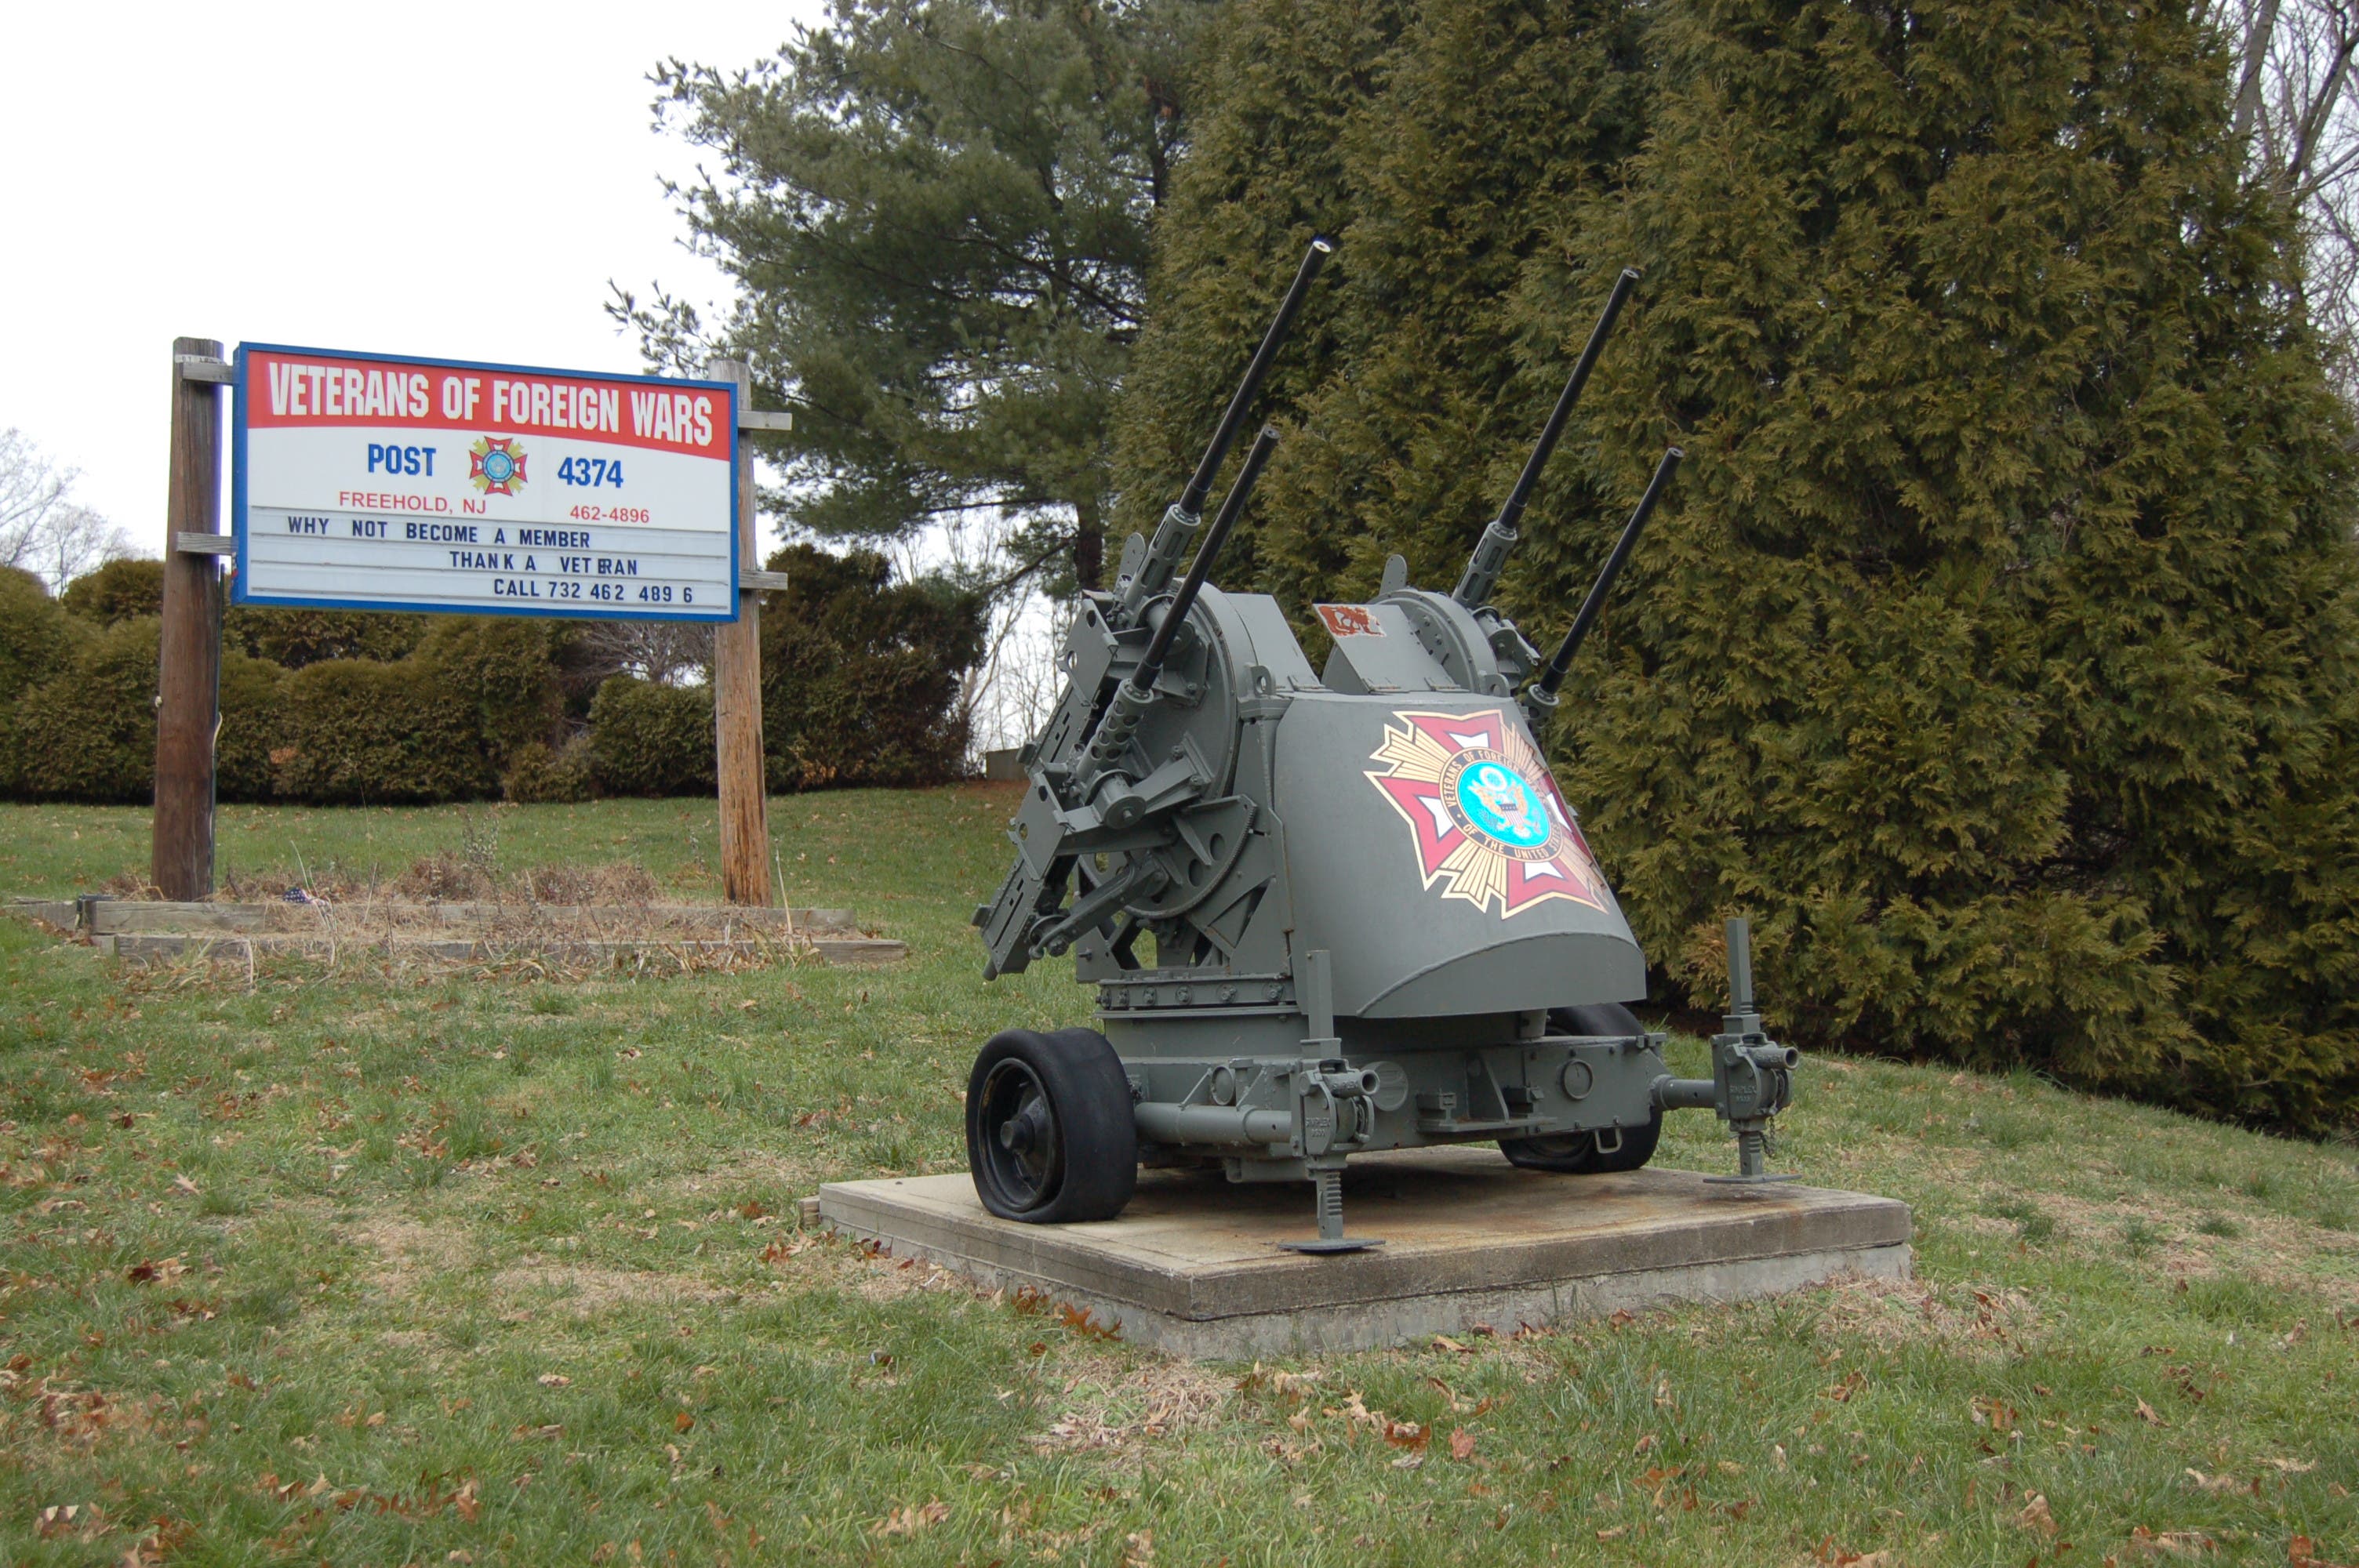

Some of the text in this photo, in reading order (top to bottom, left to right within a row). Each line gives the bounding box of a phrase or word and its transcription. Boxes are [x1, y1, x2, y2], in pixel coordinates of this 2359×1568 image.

[269, 361, 712, 447] VETERANS OF FOREIGN WARS
[368, 443, 623, 488] POST 4374
[340, 491, 486, 514] FREEHOLD, NJ
[570, 506, 649, 523] 462-4896
[288, 516, 590, 548] WHY NOT BECOME A MEMBER
[449, 550, 638, 575] THANK A VETERAN
[494, 579, 540, 597] CALL
[548, 581, 580, 598] 732
[590, 584, 624, 600] 462
[1442, 760, 1463, 808] VETERANS
[1463, 750, 1475, 762] OF
[1478, 750, 1520, 773] FOREIGN
[1463, 823, 1477, 836] OF
[1483, 836, 1505, 854] THE
[1514, 848, 1550, 860] UNITED
